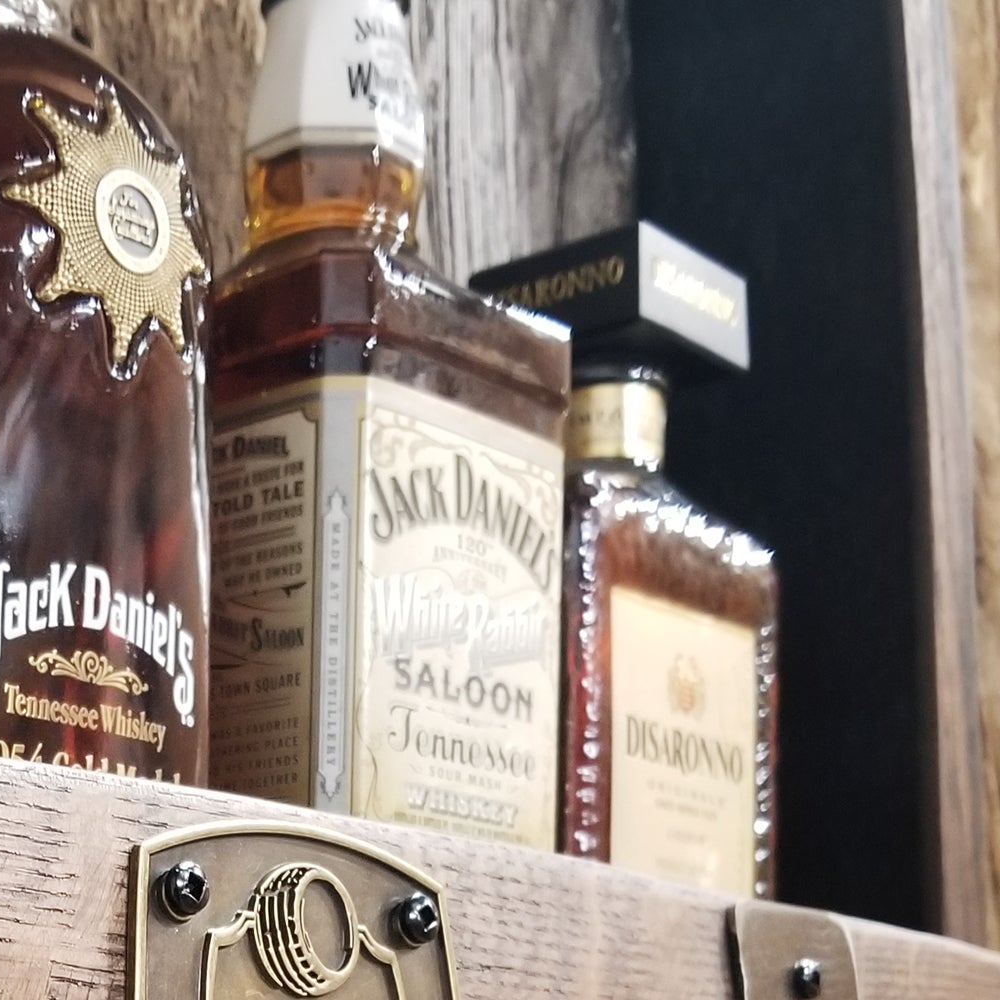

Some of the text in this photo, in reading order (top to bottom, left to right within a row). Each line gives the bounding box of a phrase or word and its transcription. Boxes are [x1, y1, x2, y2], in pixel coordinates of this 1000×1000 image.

[261, 480, 305, 506] TALE
[369, 467, 450, 542] JACK
[3, 682, 167, 753] Tennessee Whiskey
[254, 672, 302, 694] SQUARE
[326, 656, 339, 767] DISTILLERY
[393, 656, 534, 723] SALOON
[264, 735, 299, 752] PLACE
[387, 703, 537, 782] Tennessee
[625, 713, 744, 785] DISARONNO
[428, 765, 503, 792] SOUR MASH
